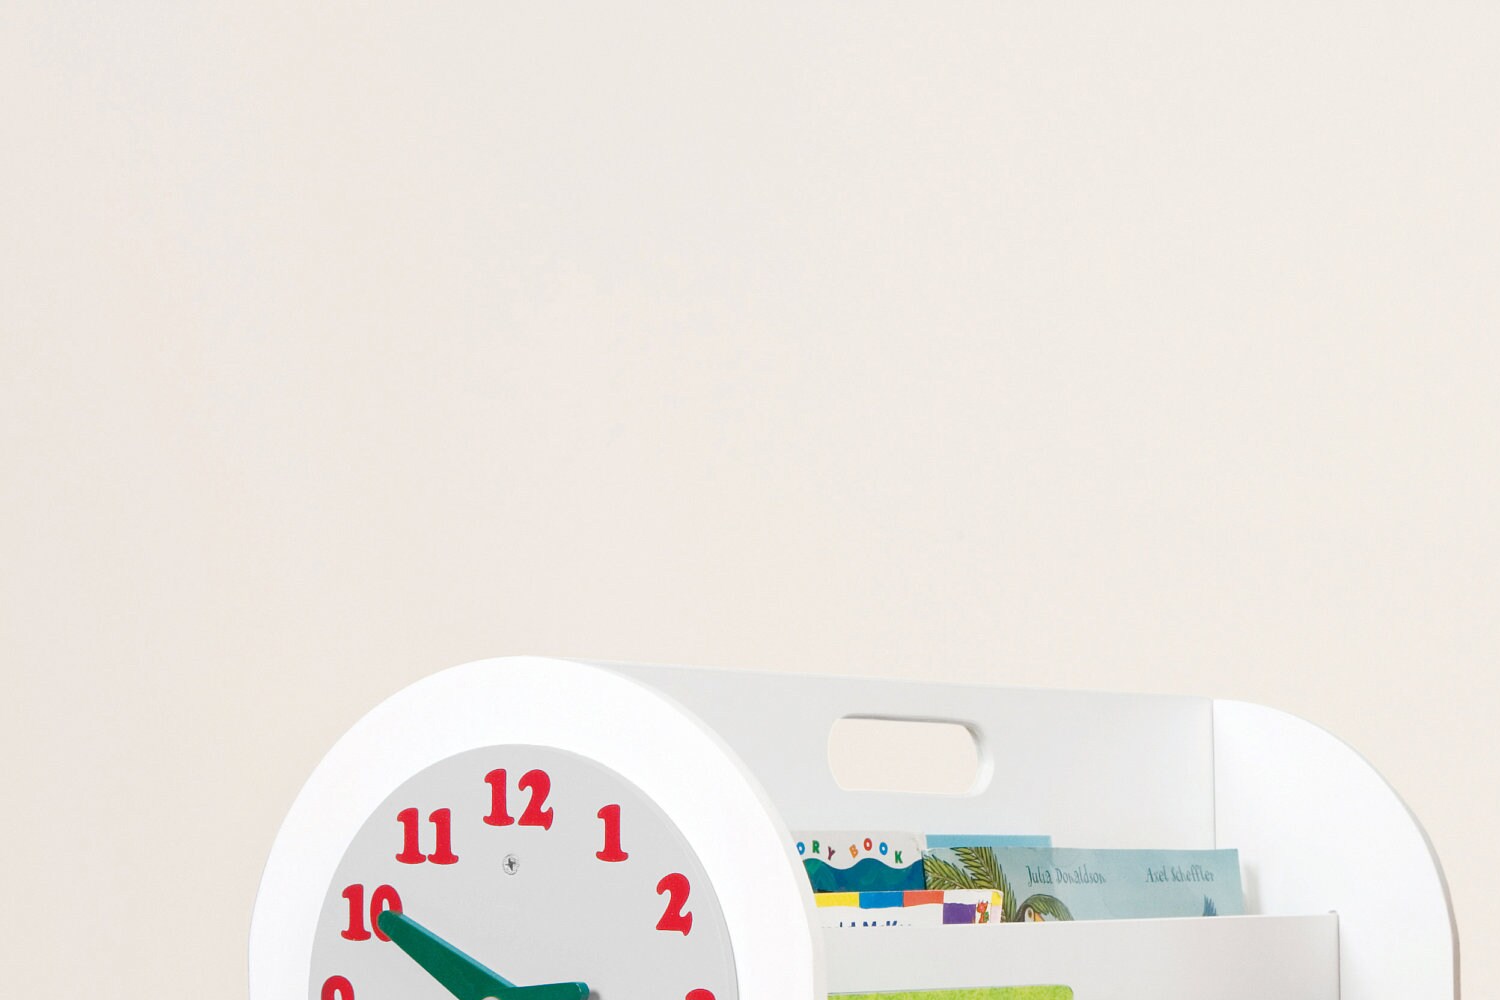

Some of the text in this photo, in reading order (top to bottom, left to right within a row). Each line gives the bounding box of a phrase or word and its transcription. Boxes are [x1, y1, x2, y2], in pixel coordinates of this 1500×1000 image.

[484, 769, 553, 830] 12
[396, 808, 458, 864] 11
[596, 804, 628, 862] 1
[797, 837, 903, 864] ORY BOOK
[1025, 864, 1107, 887] Julia Donaldson
[1145, 864, 1215, 883] Axel Scheffler
[342, 884, 402, 942] 10
[656, 873, 692, 935] 2
